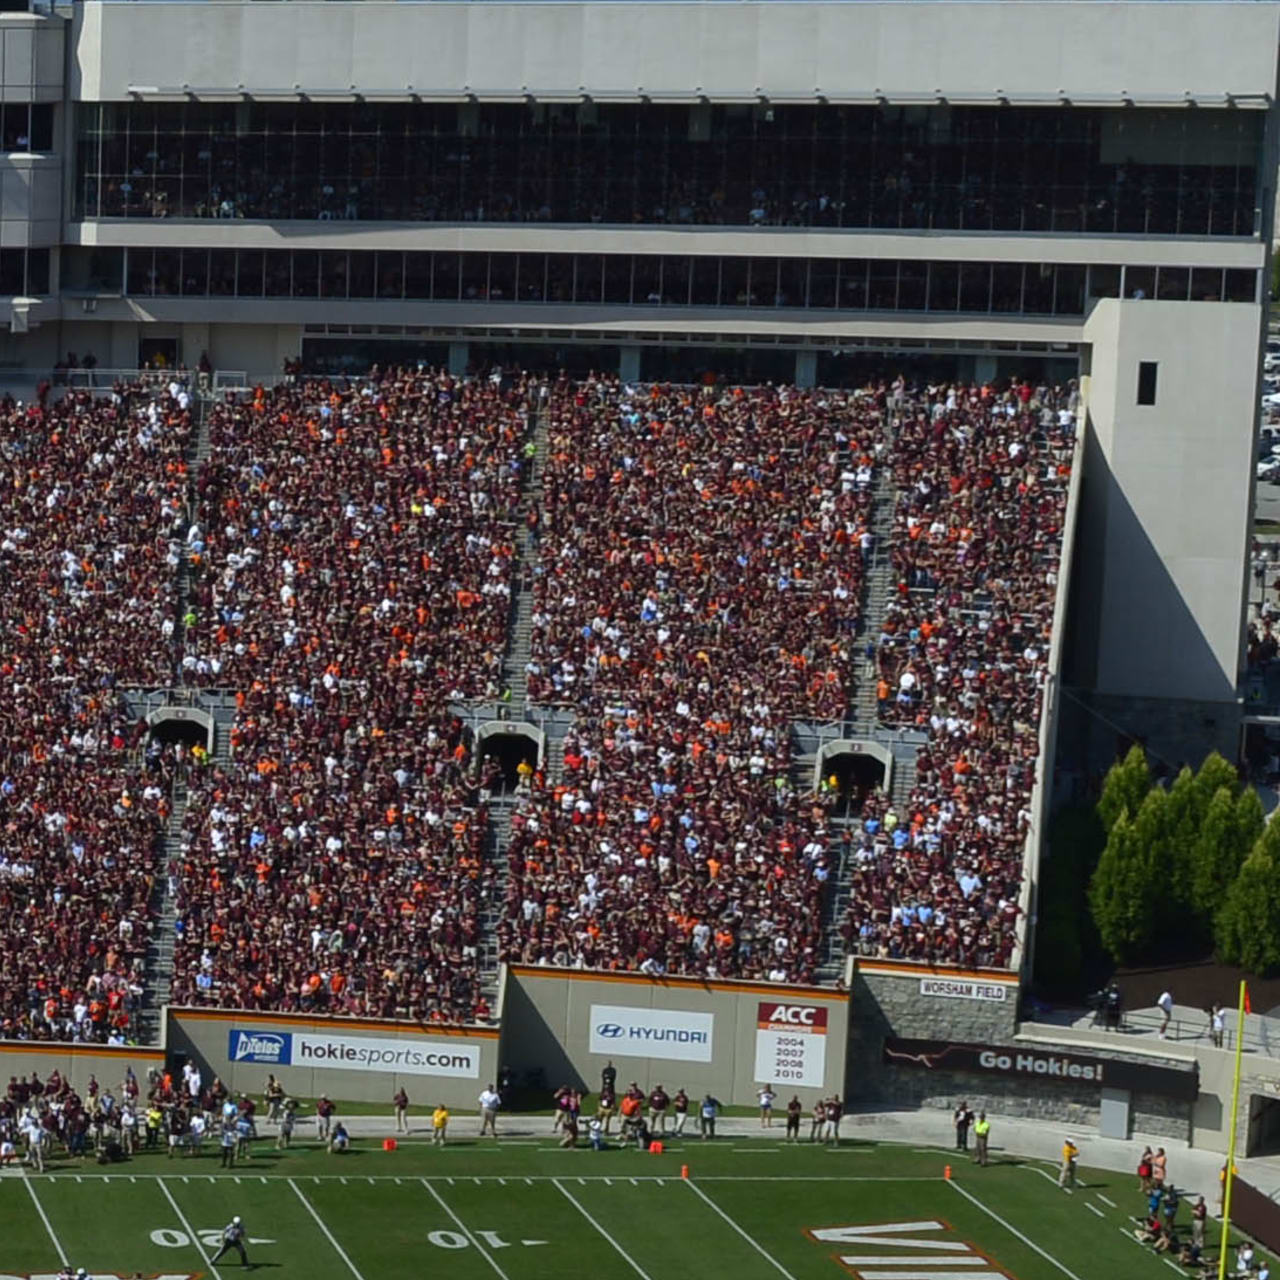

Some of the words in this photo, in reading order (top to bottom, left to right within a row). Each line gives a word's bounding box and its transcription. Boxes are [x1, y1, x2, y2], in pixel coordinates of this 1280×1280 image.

[923, 980, 973, 998] WORSHAM
[976, 985, 1004, 1001] FIELD
[769, 1005, 817, 1025] ACC
[629, 1026, 708, 1044] HYUNDAI
[776, 1036, 805, 1048] 2004
[300, 1041, 472, 1069] hokiesports.com
[776, 1047, 805, 1058] 2007
[775, 1058, 804, 1069] 2008
[979, 1051, 1012, 1070] Go
[1016, 1055, 1103, 1081] Hokies!
[774, 1068, 803, 1080] 2010
